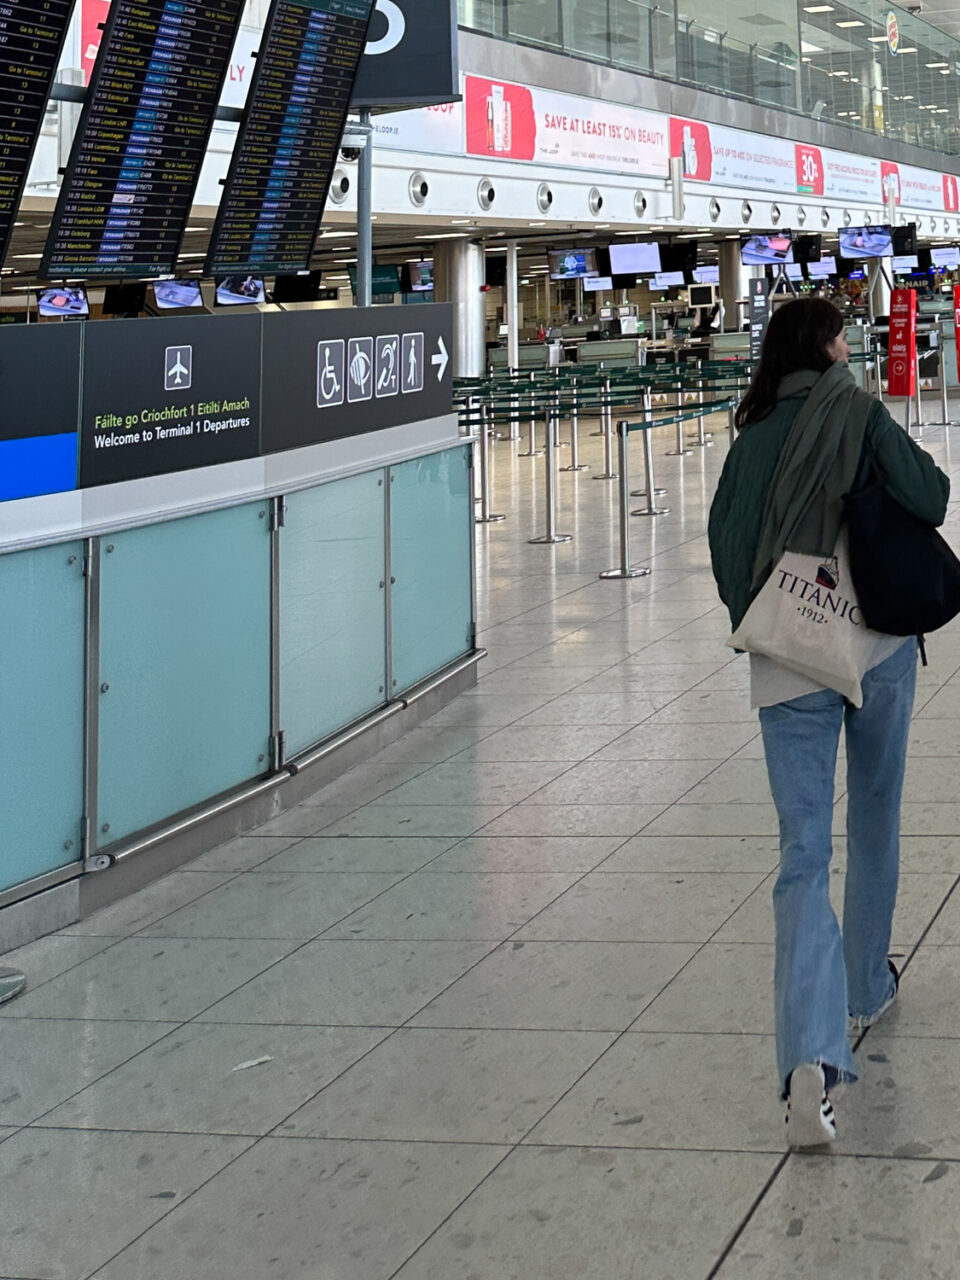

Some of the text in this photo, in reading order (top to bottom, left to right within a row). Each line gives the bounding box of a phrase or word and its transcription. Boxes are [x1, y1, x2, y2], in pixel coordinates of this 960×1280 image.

[544, 113, 665, 146] SAVE AT LEAST 15% ON BEAUTY
[95, 415, 123, 430] Fáilte
[125, 415, 138, 428] go
[190, 404, 194, 416] 1
[221, 397, 250, 412] Amach
[94, 416, 250, 449] Welcome to Terminal 1 Departures
[778, 569, 860, 626] TITANIC
